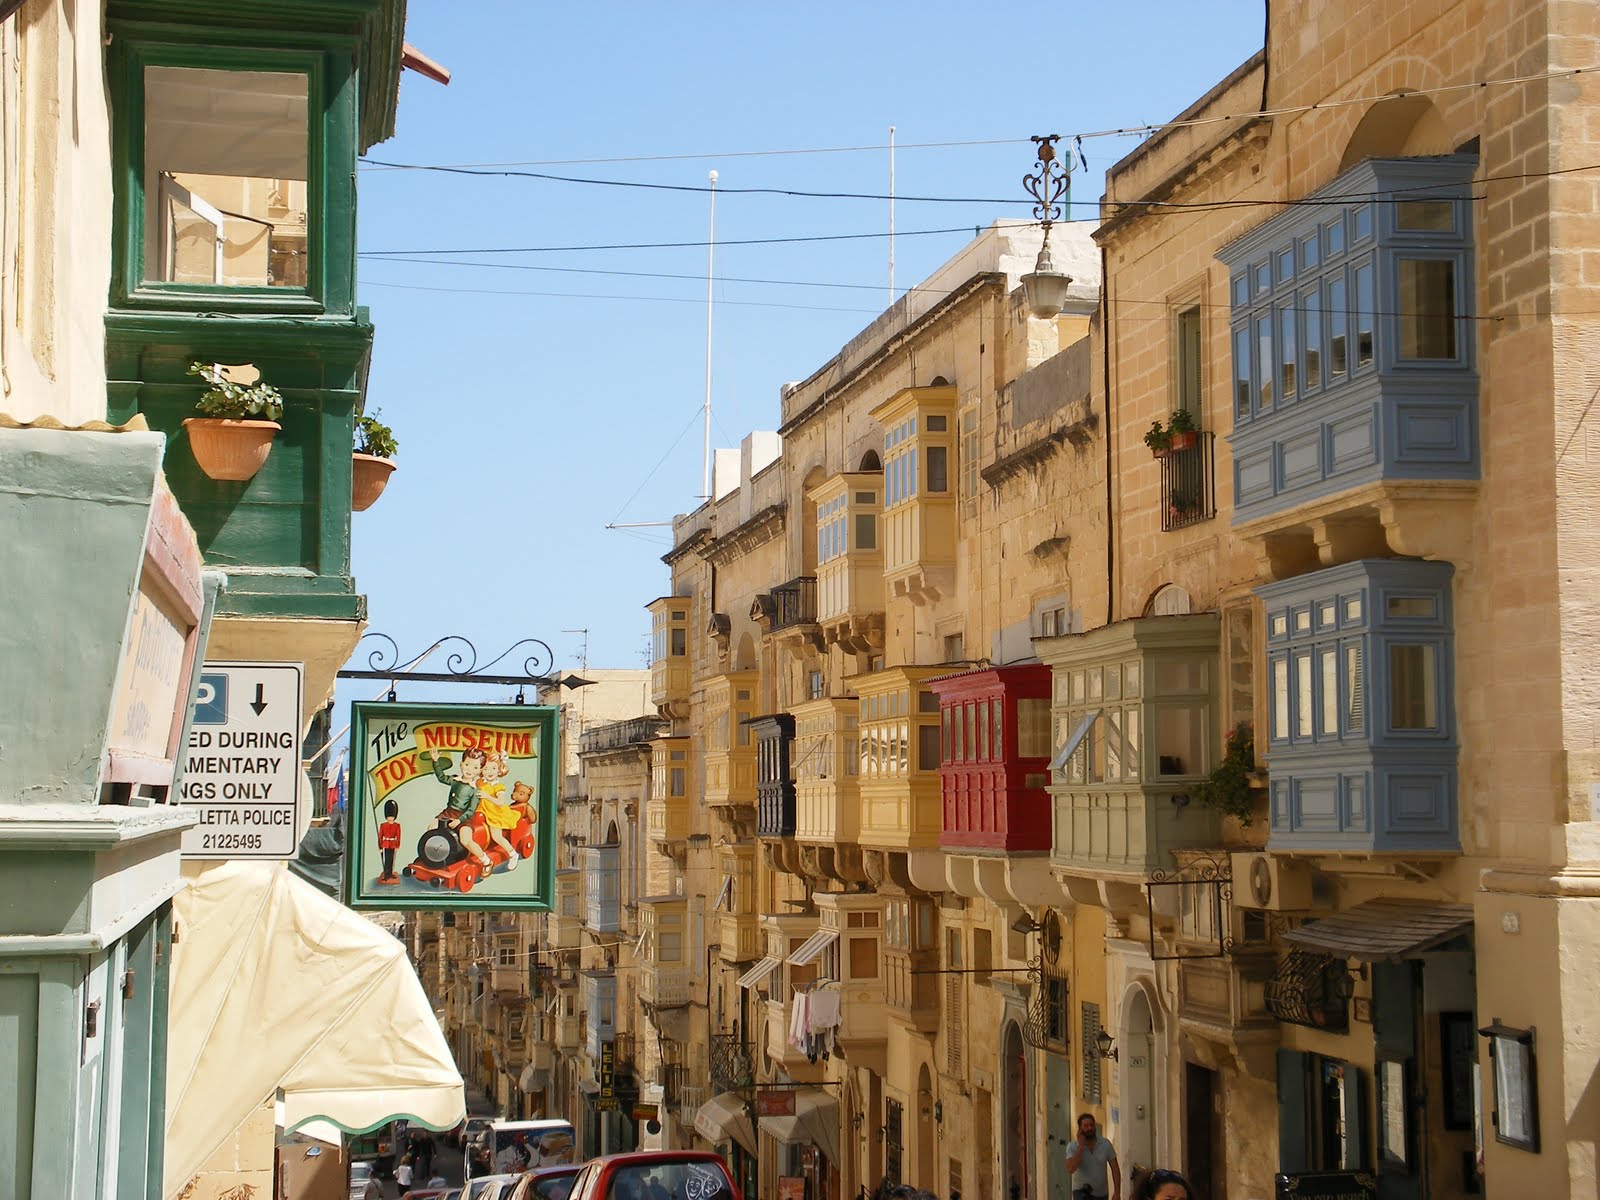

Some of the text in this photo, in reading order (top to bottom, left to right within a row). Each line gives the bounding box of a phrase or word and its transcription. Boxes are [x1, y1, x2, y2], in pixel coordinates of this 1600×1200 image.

[219, 732, 293, 749] DURING
[371, 722, 408, 762] The
[421, 726, 532, 755] MUSEUM
[376, 754, 418, 791] TOY
[223, 782, 273, 799] ONLY
[243, 810, 292, 825] POLICE
[203, 834, 262, 849] 21225495
